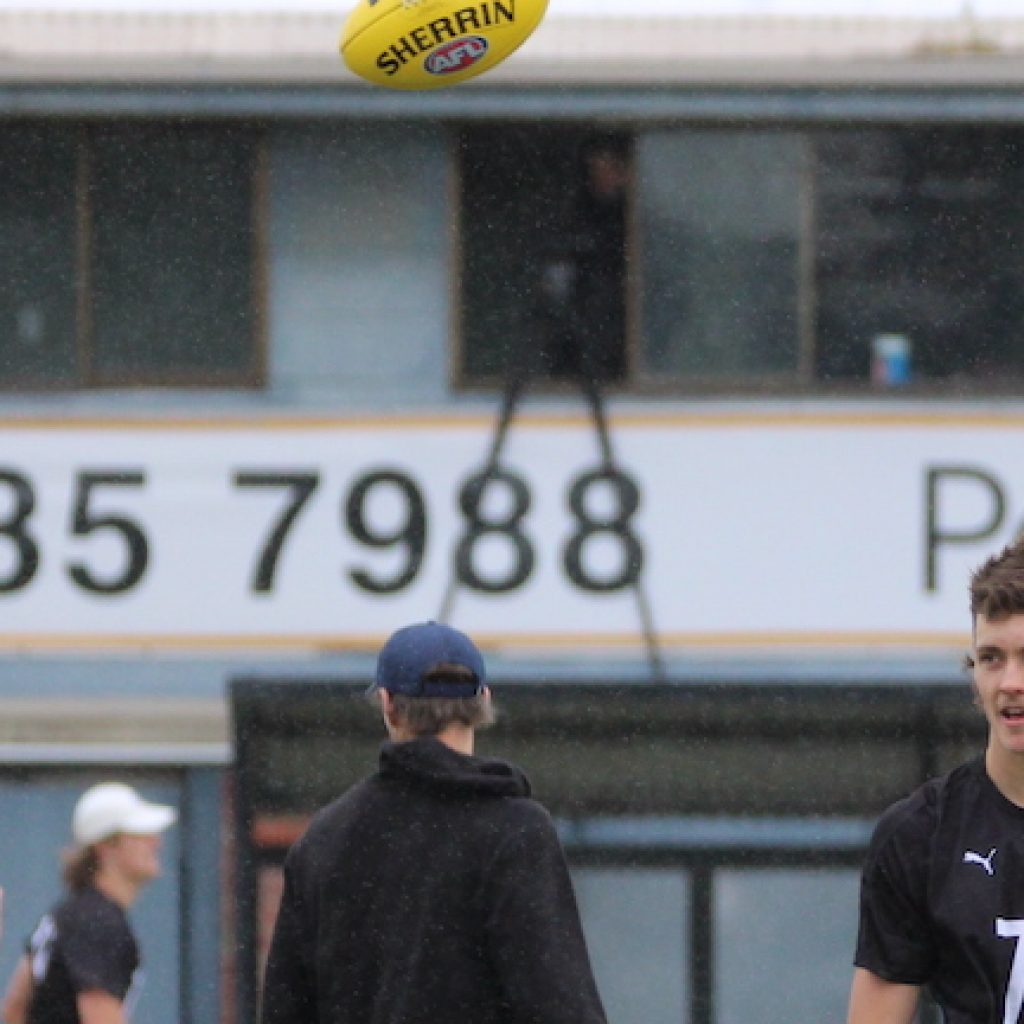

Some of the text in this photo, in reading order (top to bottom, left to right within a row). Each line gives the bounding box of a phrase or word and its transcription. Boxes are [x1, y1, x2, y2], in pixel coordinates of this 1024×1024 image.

[376, 0, 516, 76] SHERRIN
[432, 42, 484, 74] AFL
[231, 468, 645, 595] 7988
